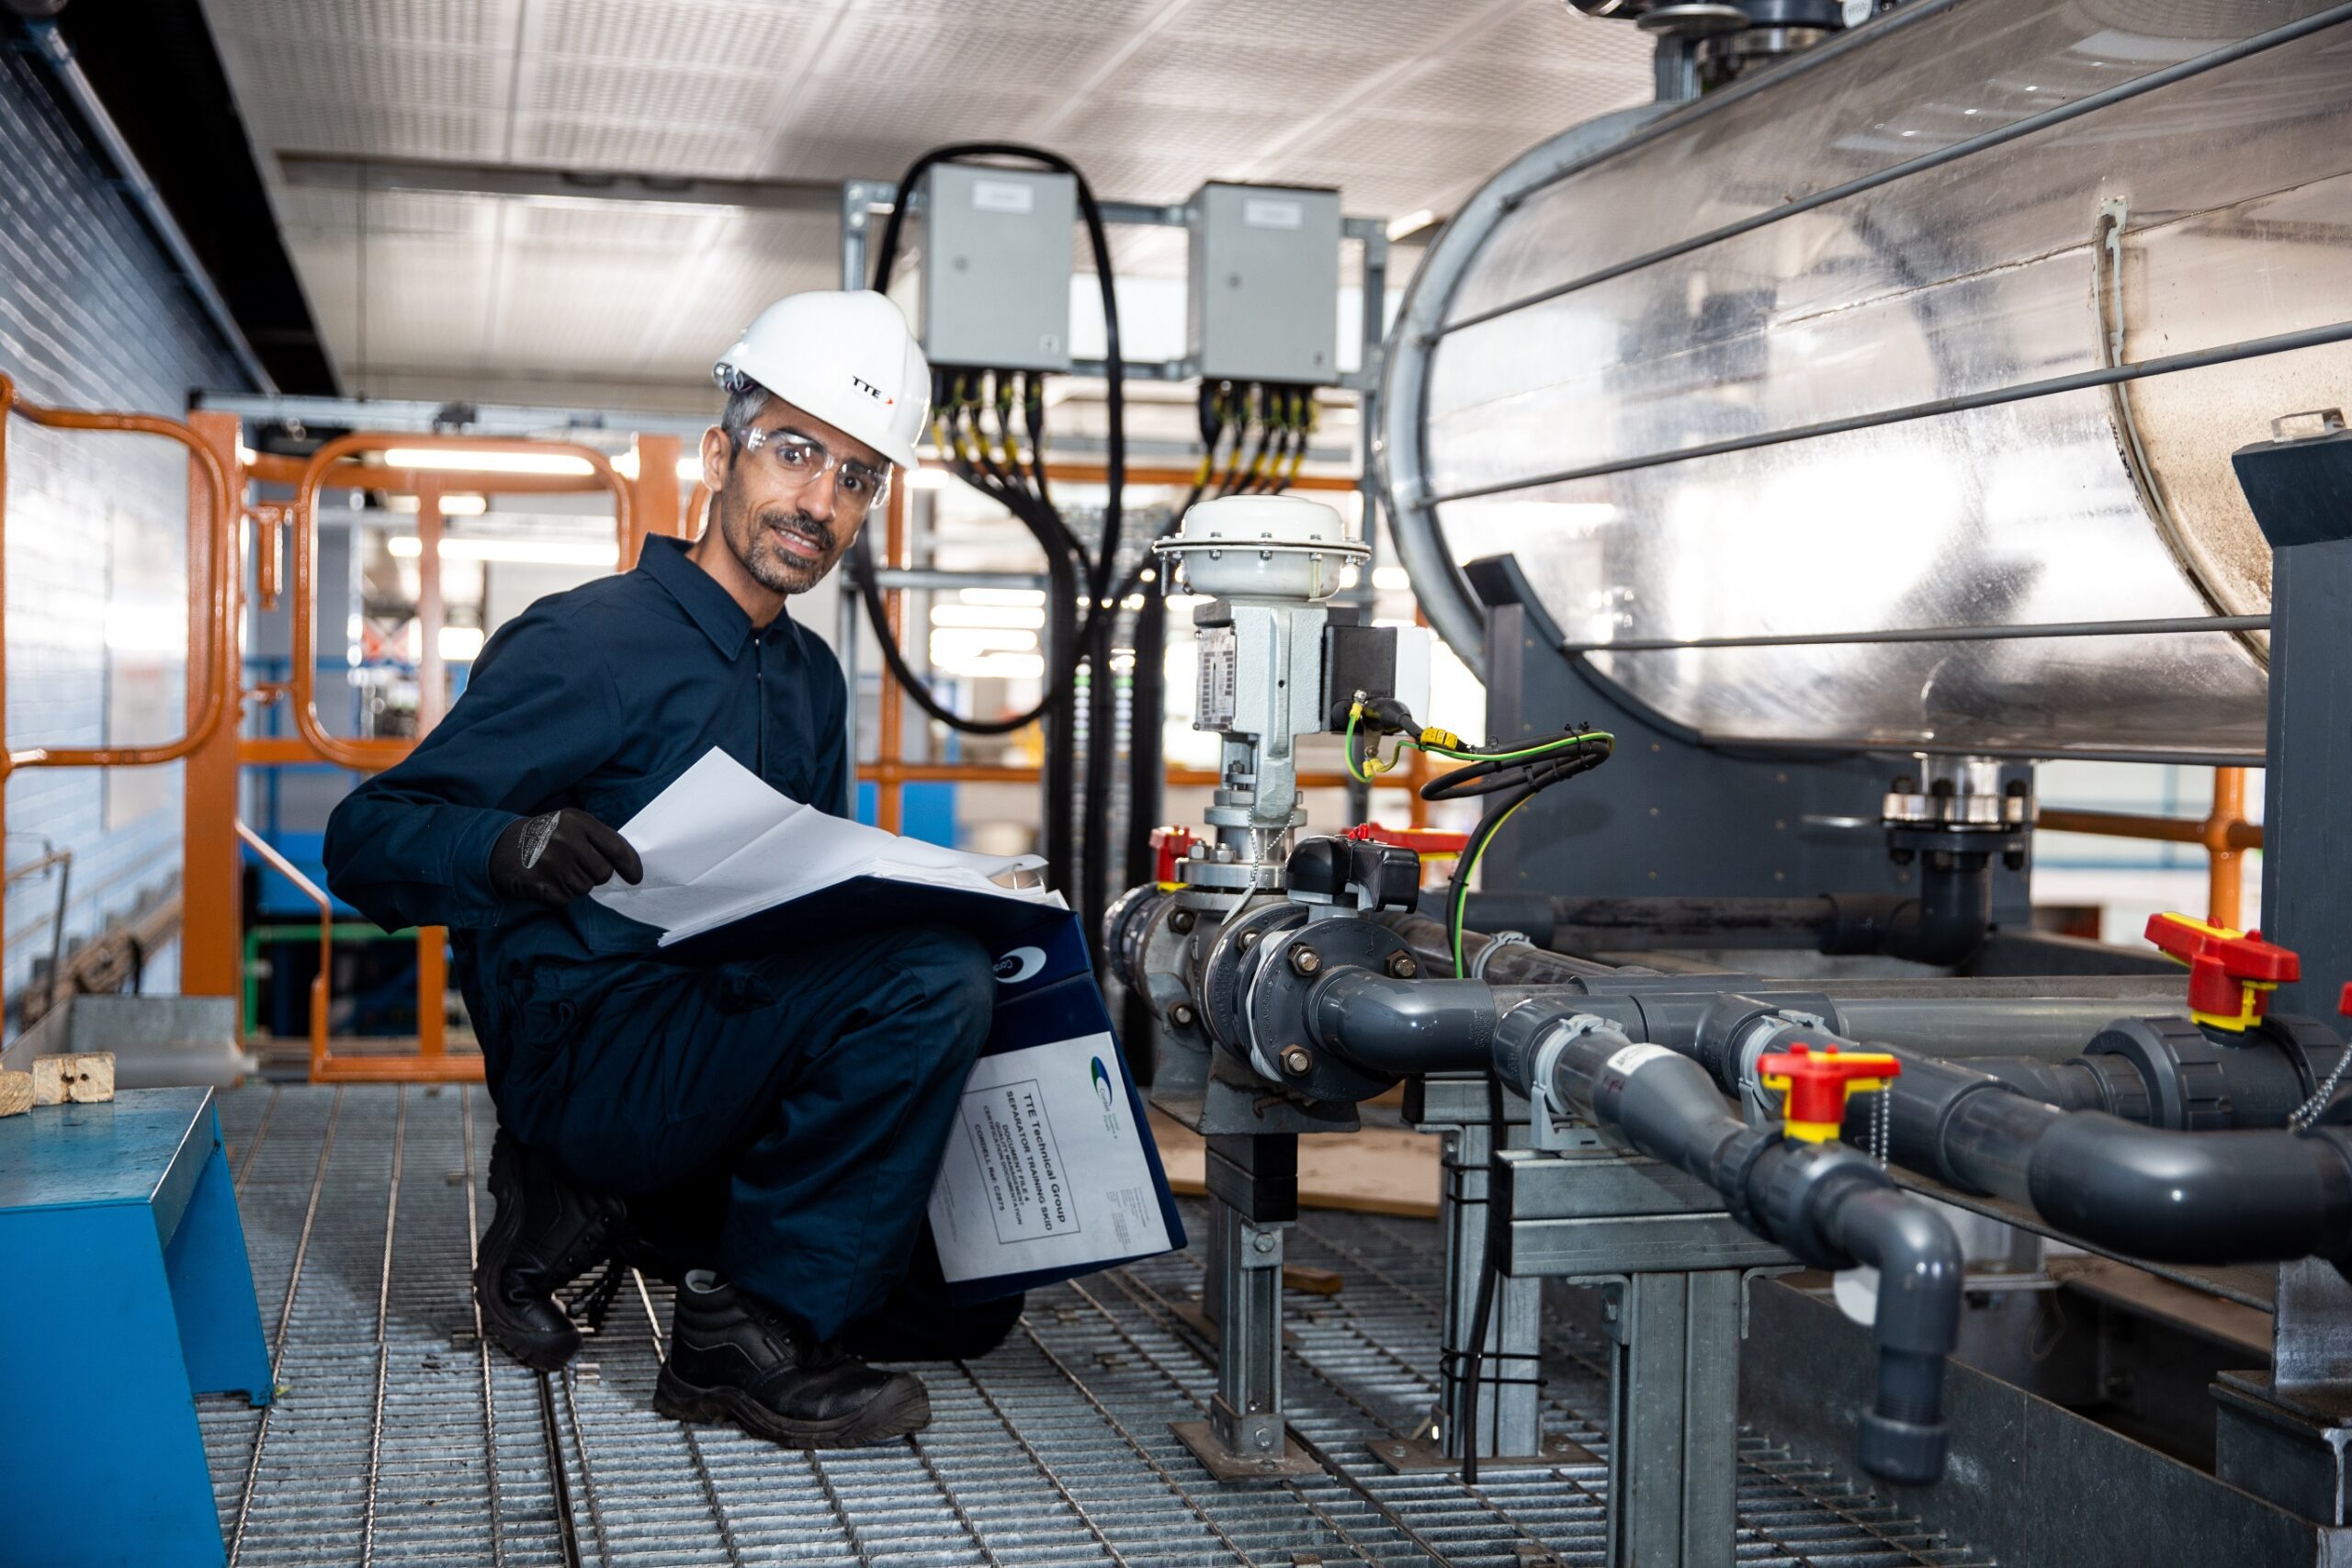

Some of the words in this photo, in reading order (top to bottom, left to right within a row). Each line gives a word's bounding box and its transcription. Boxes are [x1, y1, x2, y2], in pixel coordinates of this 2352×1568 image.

[853, 376, 882, 399] TTE
[974, 1123, 991, 1165] CORDELL
[983, 1105, 1004, 1160] CERTIFICATION
[1001, 1161, 1023, 1225] DOCUMENTATION
[994, 1122, 1009, 1152] QUALITY
[1005, 1154, 1024, 1206] MANAGEMENT
[1002, 1123, 1023, 1173] DOCUMENT
[1018, 1175, 1028, 1193] FILE
[1006, 1090, 1031, 1153] SEPARATOR
[1026, 1156, 1046, 1203] TRAINING
[1041, 1206, 1053, 1231] SKID
[1023, 1093, 1037, 1118] TTE
[1032, 1122, 1057, 1179] Technical
[1051, 1183, 1067, 1223] Group
